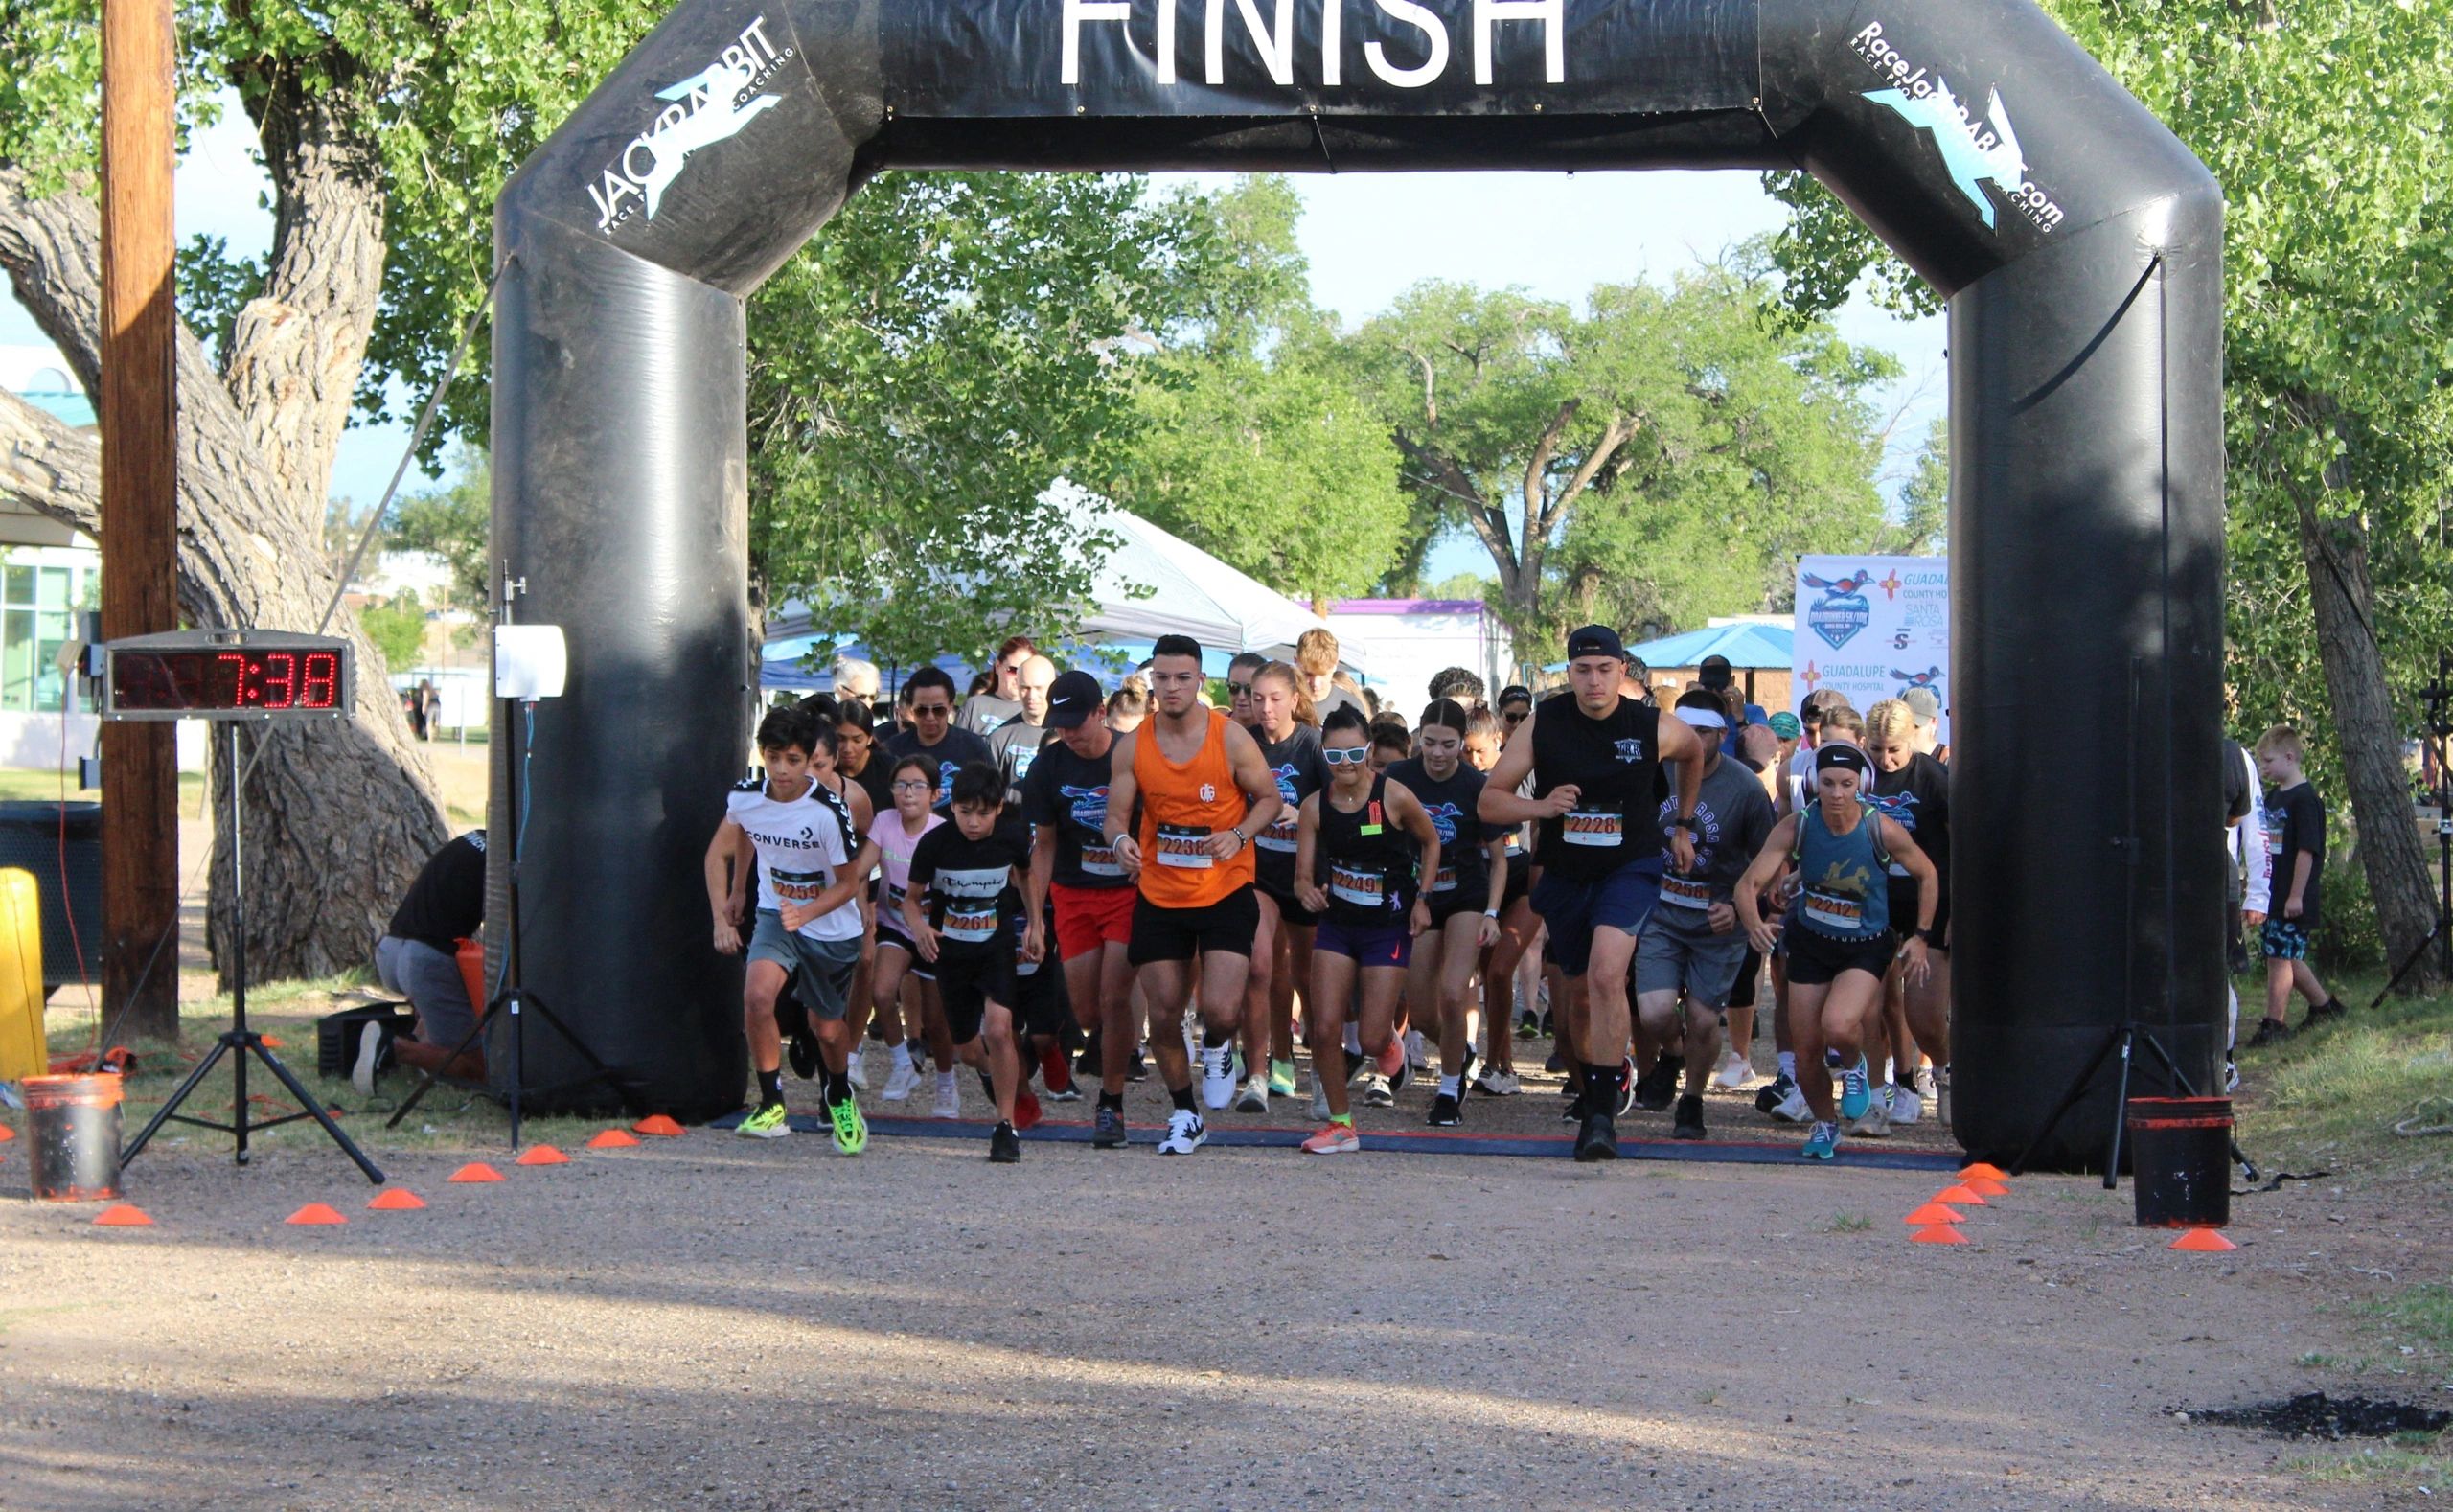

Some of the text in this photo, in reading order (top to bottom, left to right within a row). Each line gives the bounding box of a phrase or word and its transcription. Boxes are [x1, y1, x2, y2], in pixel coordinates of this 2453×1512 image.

[1061, 0, 1565, 88] FINISH
[1849, 36, 1883, 70] RACE
[604, 47, 795, 237] RACE COACHING
[1902, 589, 1934, 599] COUNTY
[1905, 604, 1940, 614] SANTA
[1914, 614, 1944, 628] ROSA
[218, 653, 335, 709] 7:38
[1823, 664, 1886, 678] GUADALUPE
[1822, 681, 1885, 691] COUNTY HOSPITAL
[1570, 815, 1616, 835] 2228
[1694, 801, 1720, 843] ROSA
[745, 830, 821, 850] CONVERSE
[775, 882, 820, 901] 2259
[1335, 871, 1376, 894] 2249
[1663, 878, 1704, 900] 2258
[949, 914, 991, 931] 2261
